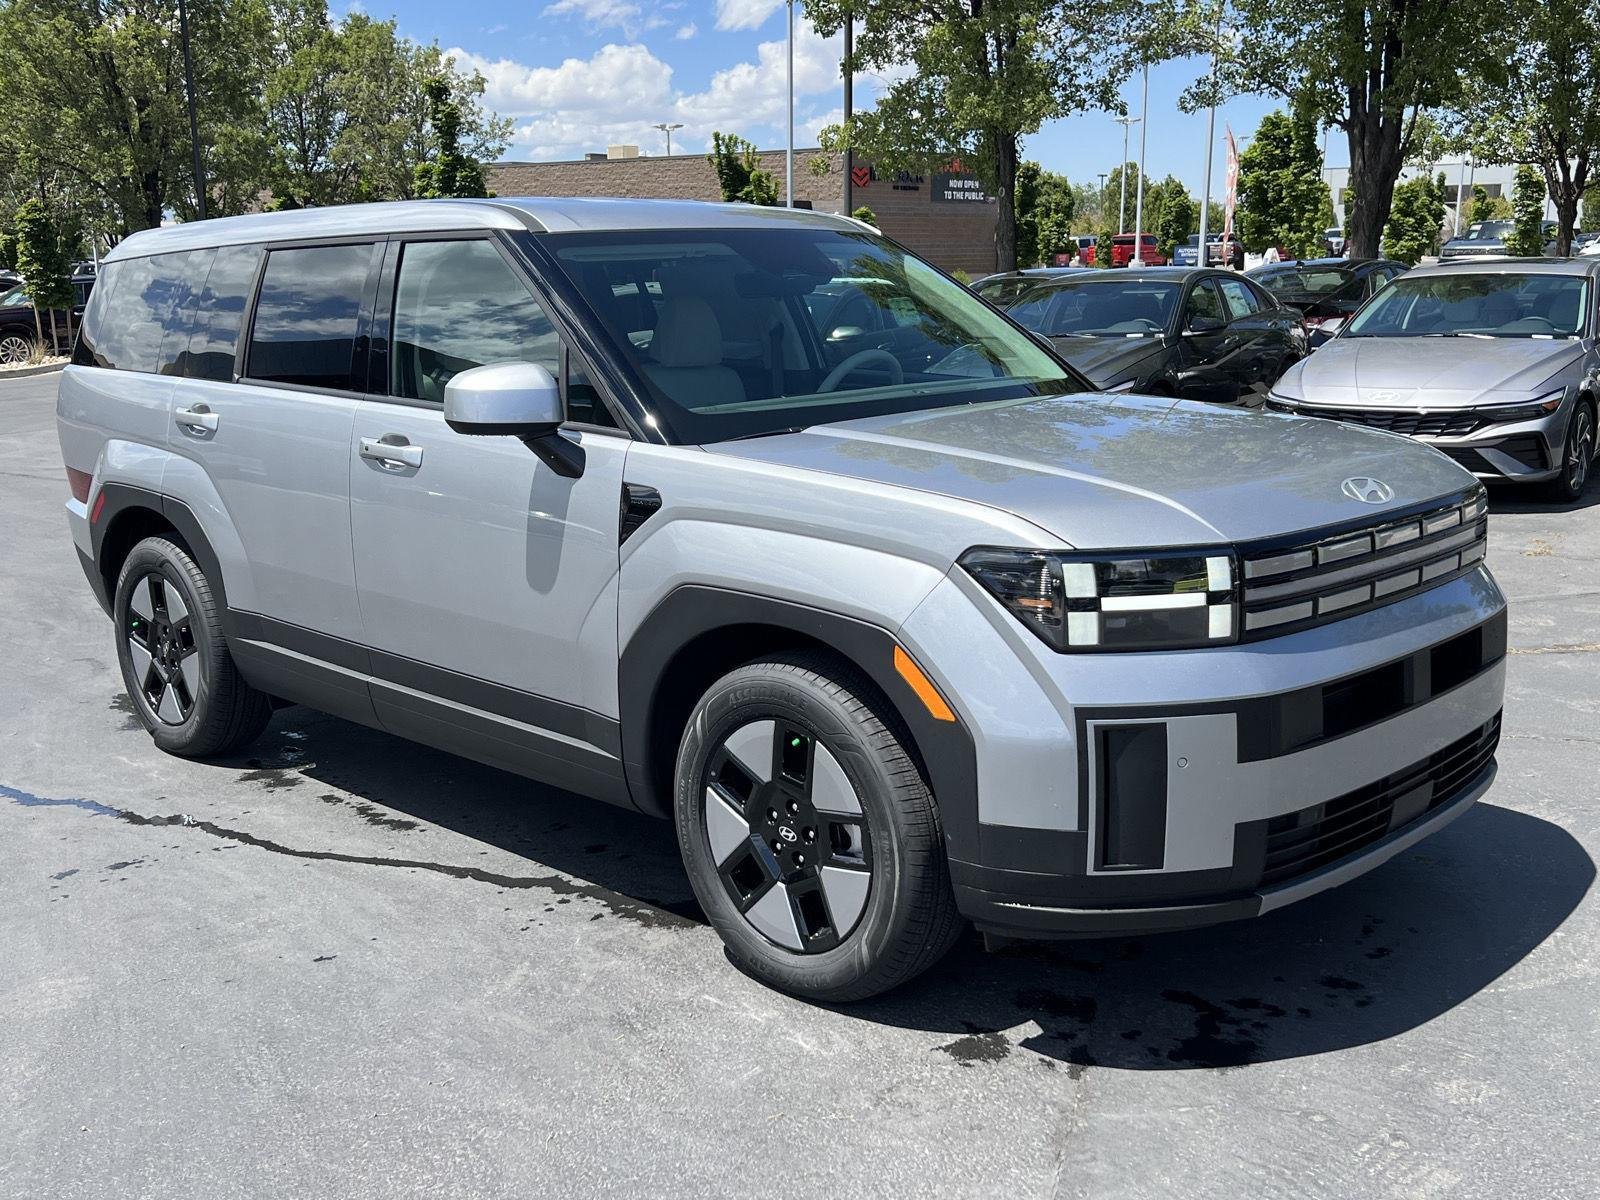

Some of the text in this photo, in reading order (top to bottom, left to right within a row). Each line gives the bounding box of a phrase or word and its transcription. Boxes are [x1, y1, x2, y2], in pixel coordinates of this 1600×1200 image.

[949, 179, 979, 189] NOW OPEN
[944, 191, 984, 200] TO THE PUBLIC
